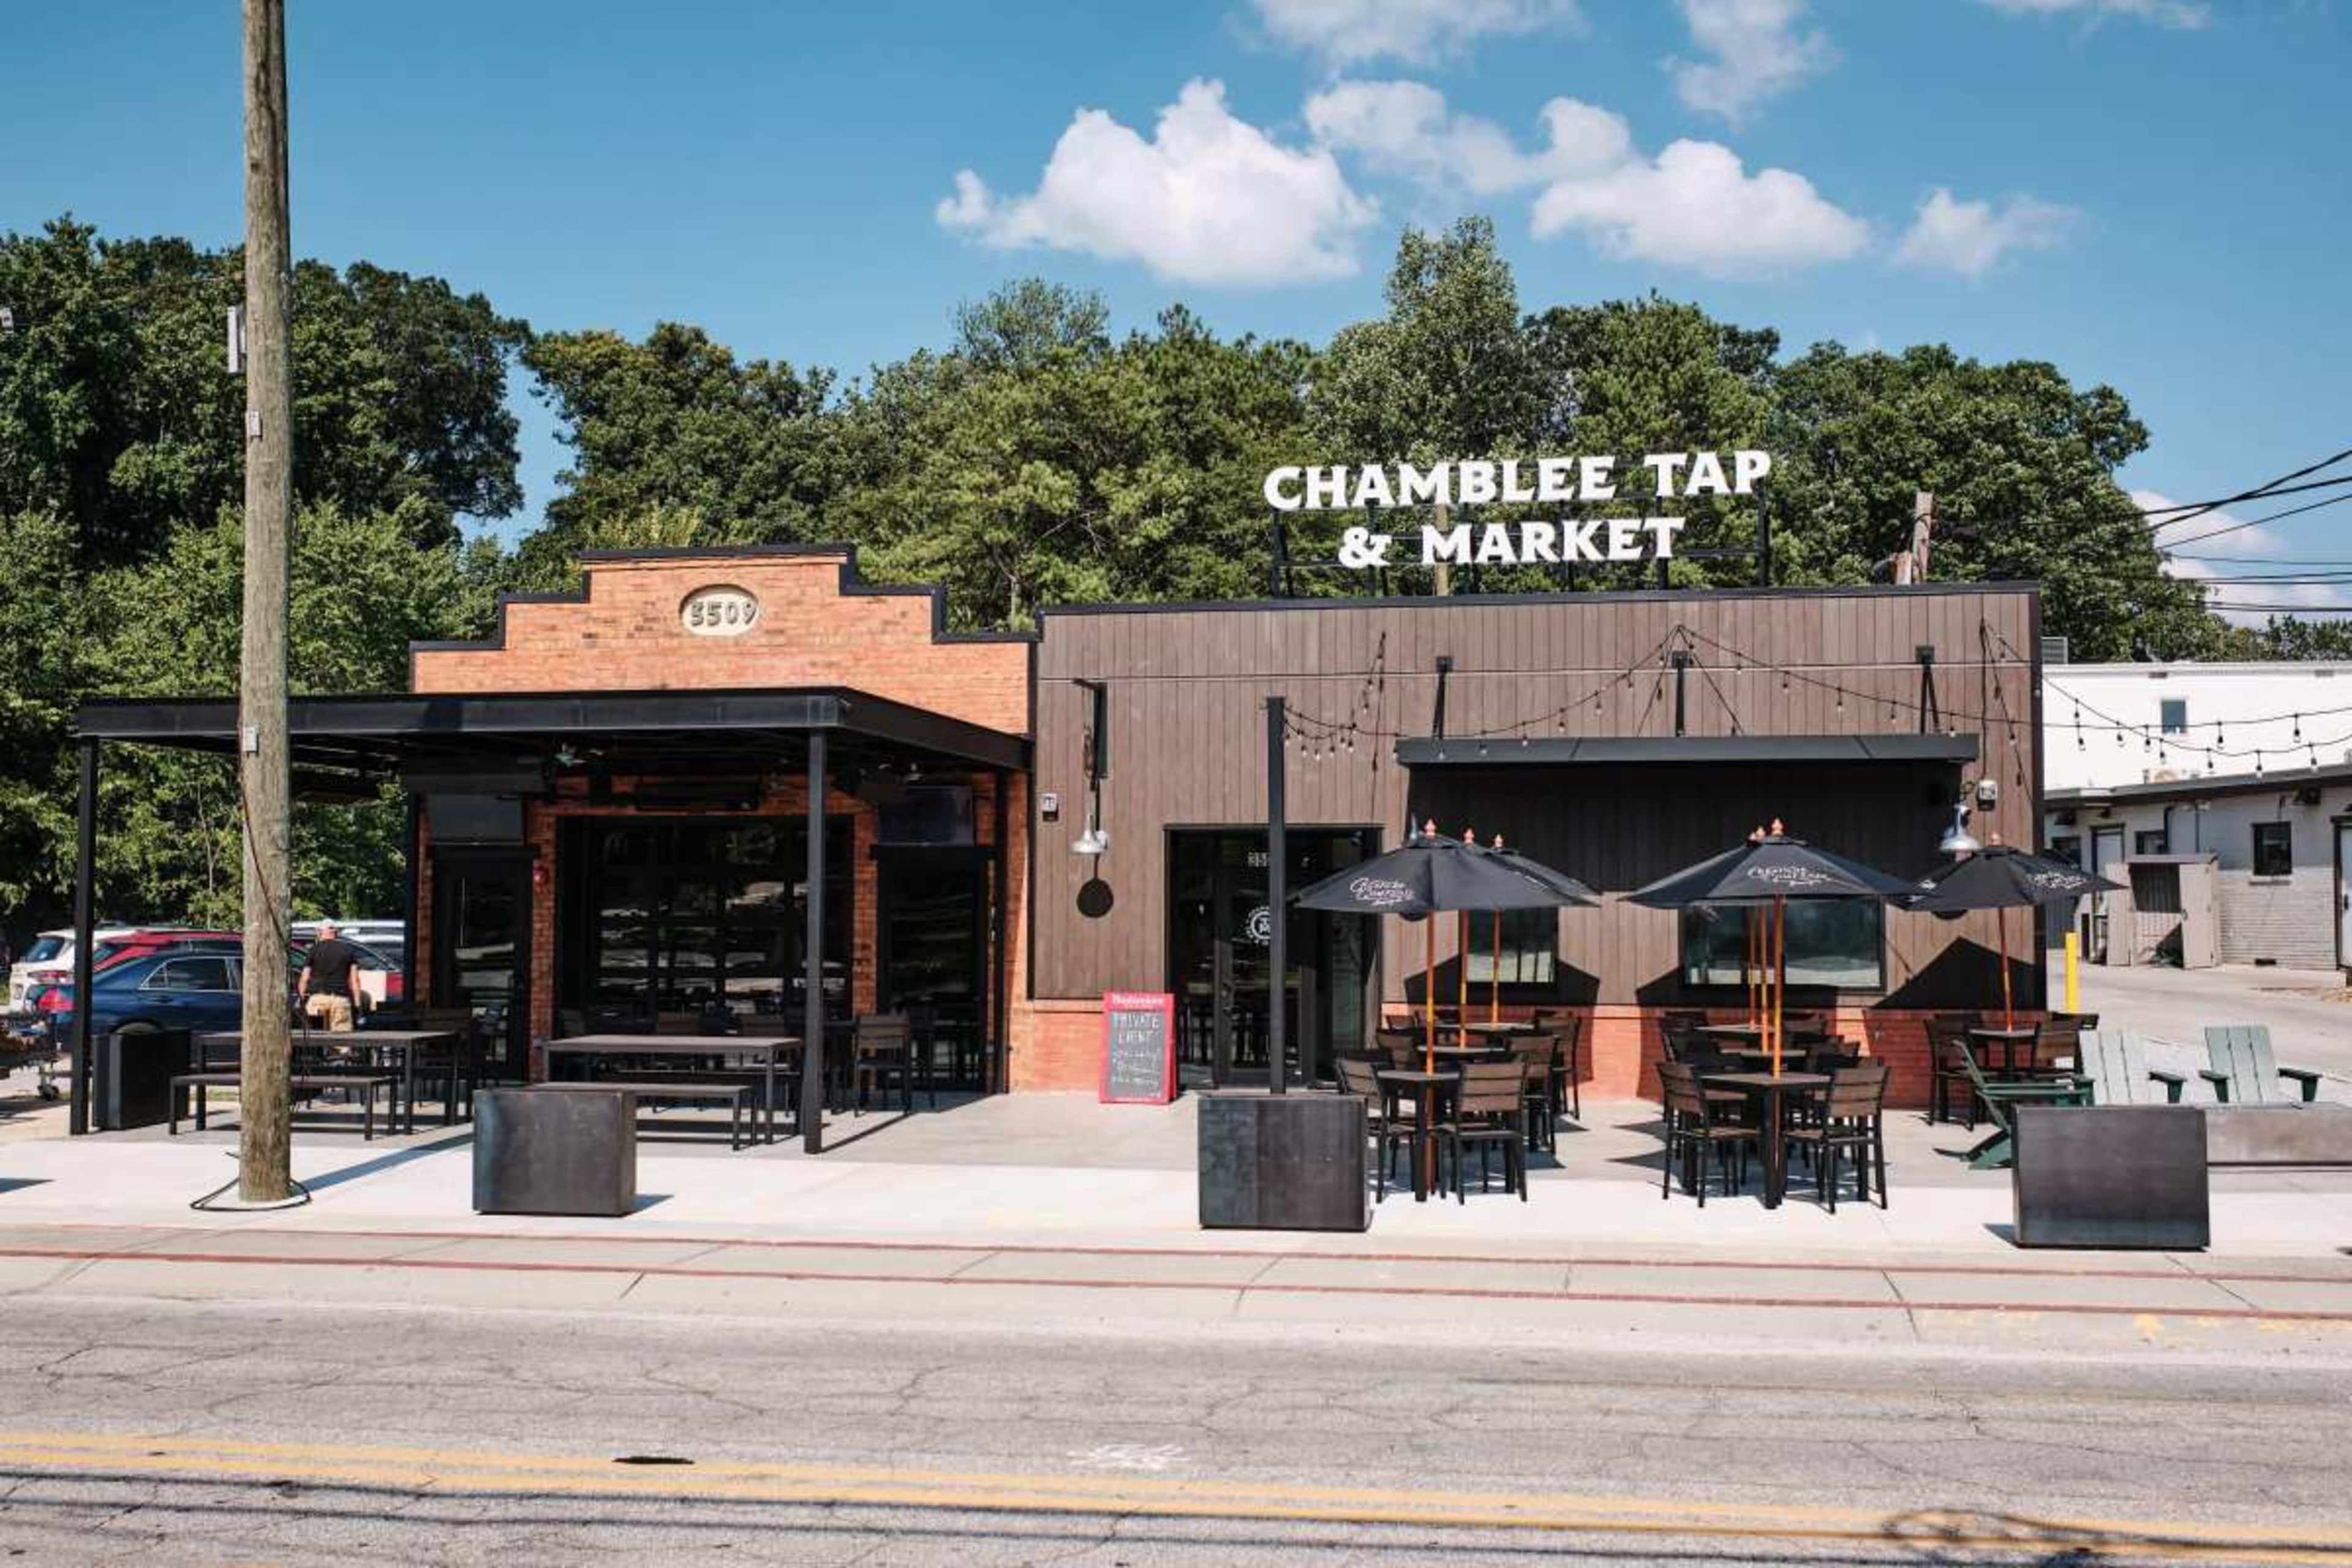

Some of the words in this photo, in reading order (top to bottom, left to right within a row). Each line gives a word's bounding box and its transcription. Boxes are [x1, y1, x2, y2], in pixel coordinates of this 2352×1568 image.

[1264, 455, 1618, 511] CHAMBLEE
[1644, 450, 1771, 497] TAP
[1338, 527, 1392, 568] &
[1421, 517, 1686, 565] MARKET
